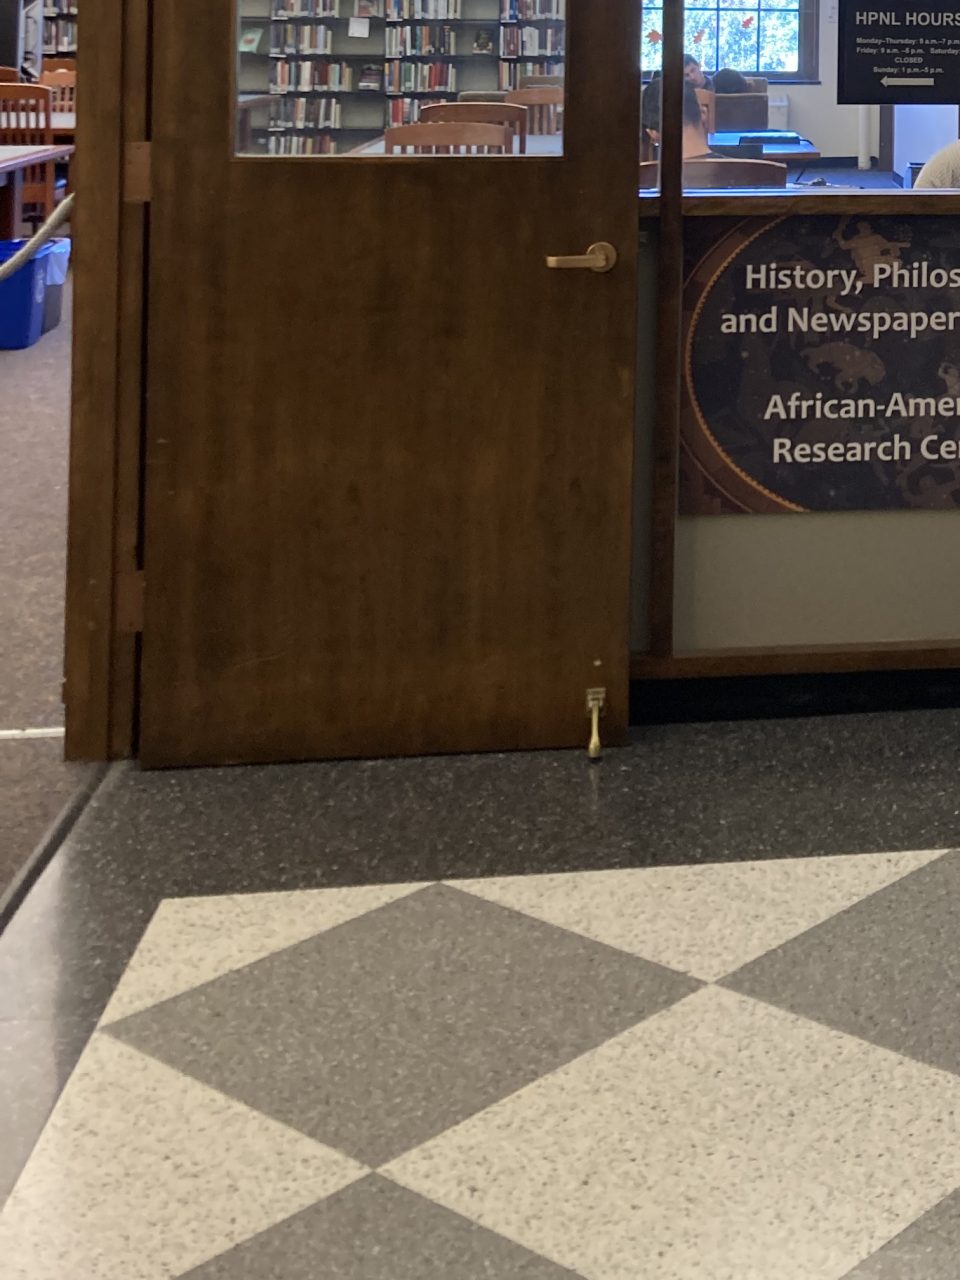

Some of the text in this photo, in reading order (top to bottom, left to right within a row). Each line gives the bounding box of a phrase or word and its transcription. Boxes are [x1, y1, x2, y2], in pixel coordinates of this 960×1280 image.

[855, 11, 901, 26] HPNL
[894, 56, 924, 64] CLOSED
[745, 262, 864, 296] History,
[719, 306, 778, 334] and
[786, 305, 960, 339] Newspaper
[772, 434, 912, 464] Research
